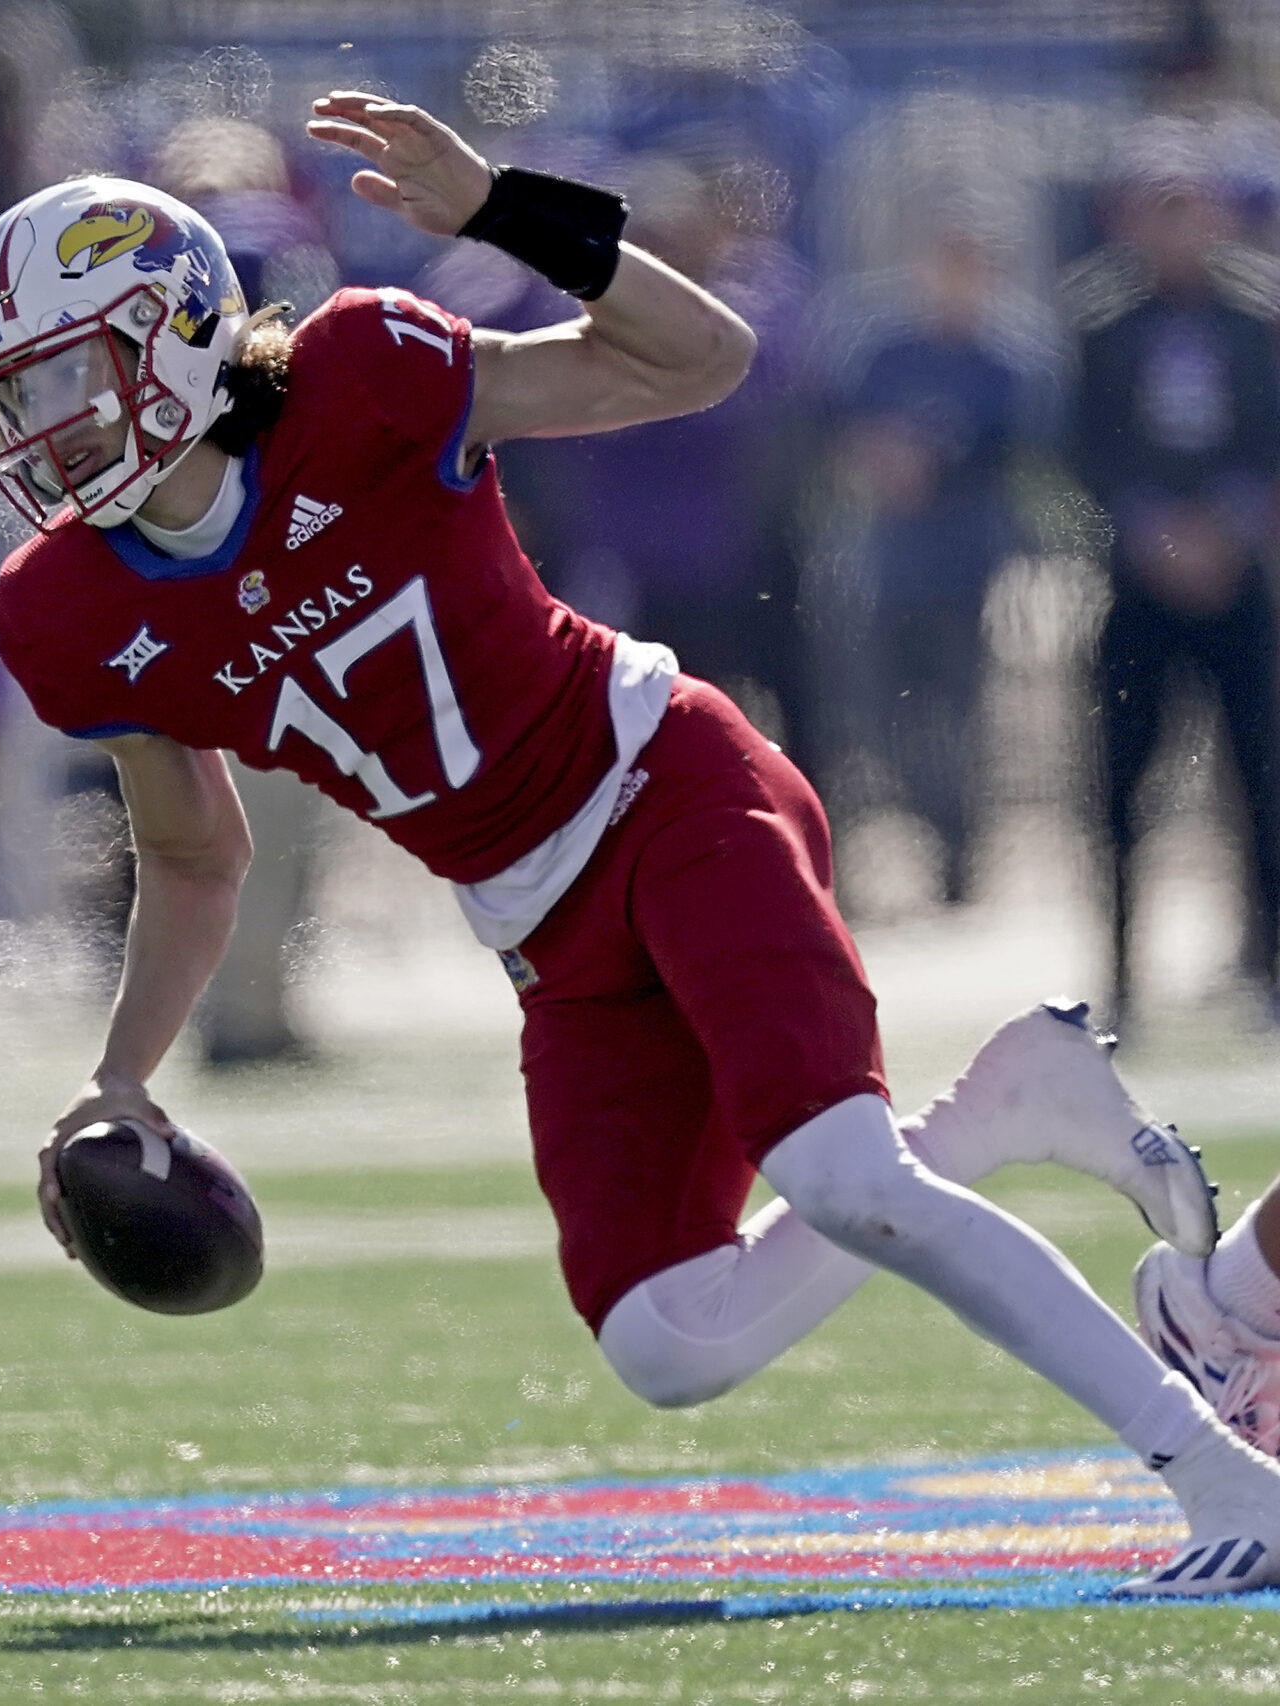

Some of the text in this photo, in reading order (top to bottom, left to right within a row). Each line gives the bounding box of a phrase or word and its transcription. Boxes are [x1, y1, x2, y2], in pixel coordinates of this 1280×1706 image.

[376, 286, 453, 367] 17
[286, 503, 344, 550] adidas
[213, 564, 373, 695] KANSAS
[265, 574, 482, 819] 17
